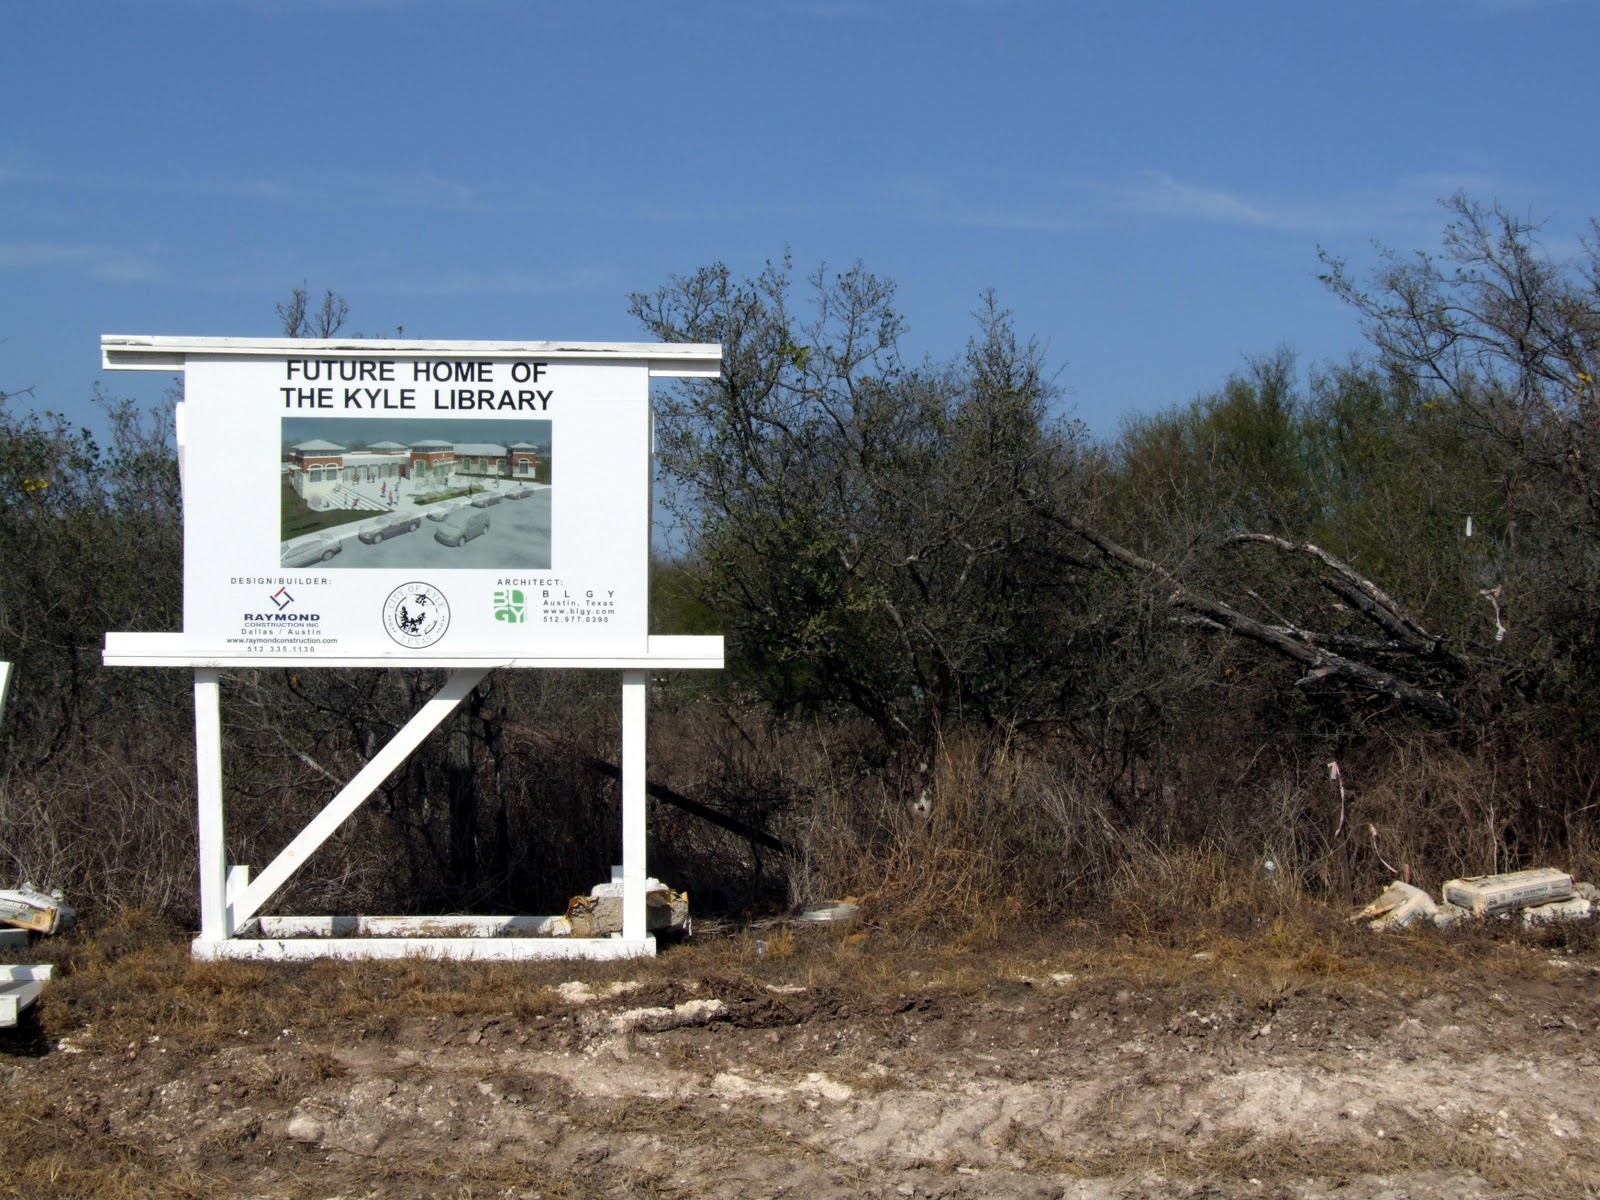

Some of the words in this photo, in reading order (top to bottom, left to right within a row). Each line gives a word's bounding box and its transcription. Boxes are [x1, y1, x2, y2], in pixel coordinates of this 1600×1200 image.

[286, 360, 395, 381] FUTURE
[413, 361, 493, 383] HOME
[511, 362, 548, 383] OF
[280, 388, 334, 408] THE
[344, 388, 416, 409] KYLE
[434, 390, 554, 411] LIBRARY
[543, 608, 615, 616] www.blgy.com
[244, 613, 320, 621] RAYMOND
[226, 637, 338, 645] www.raymondconstruction.com
